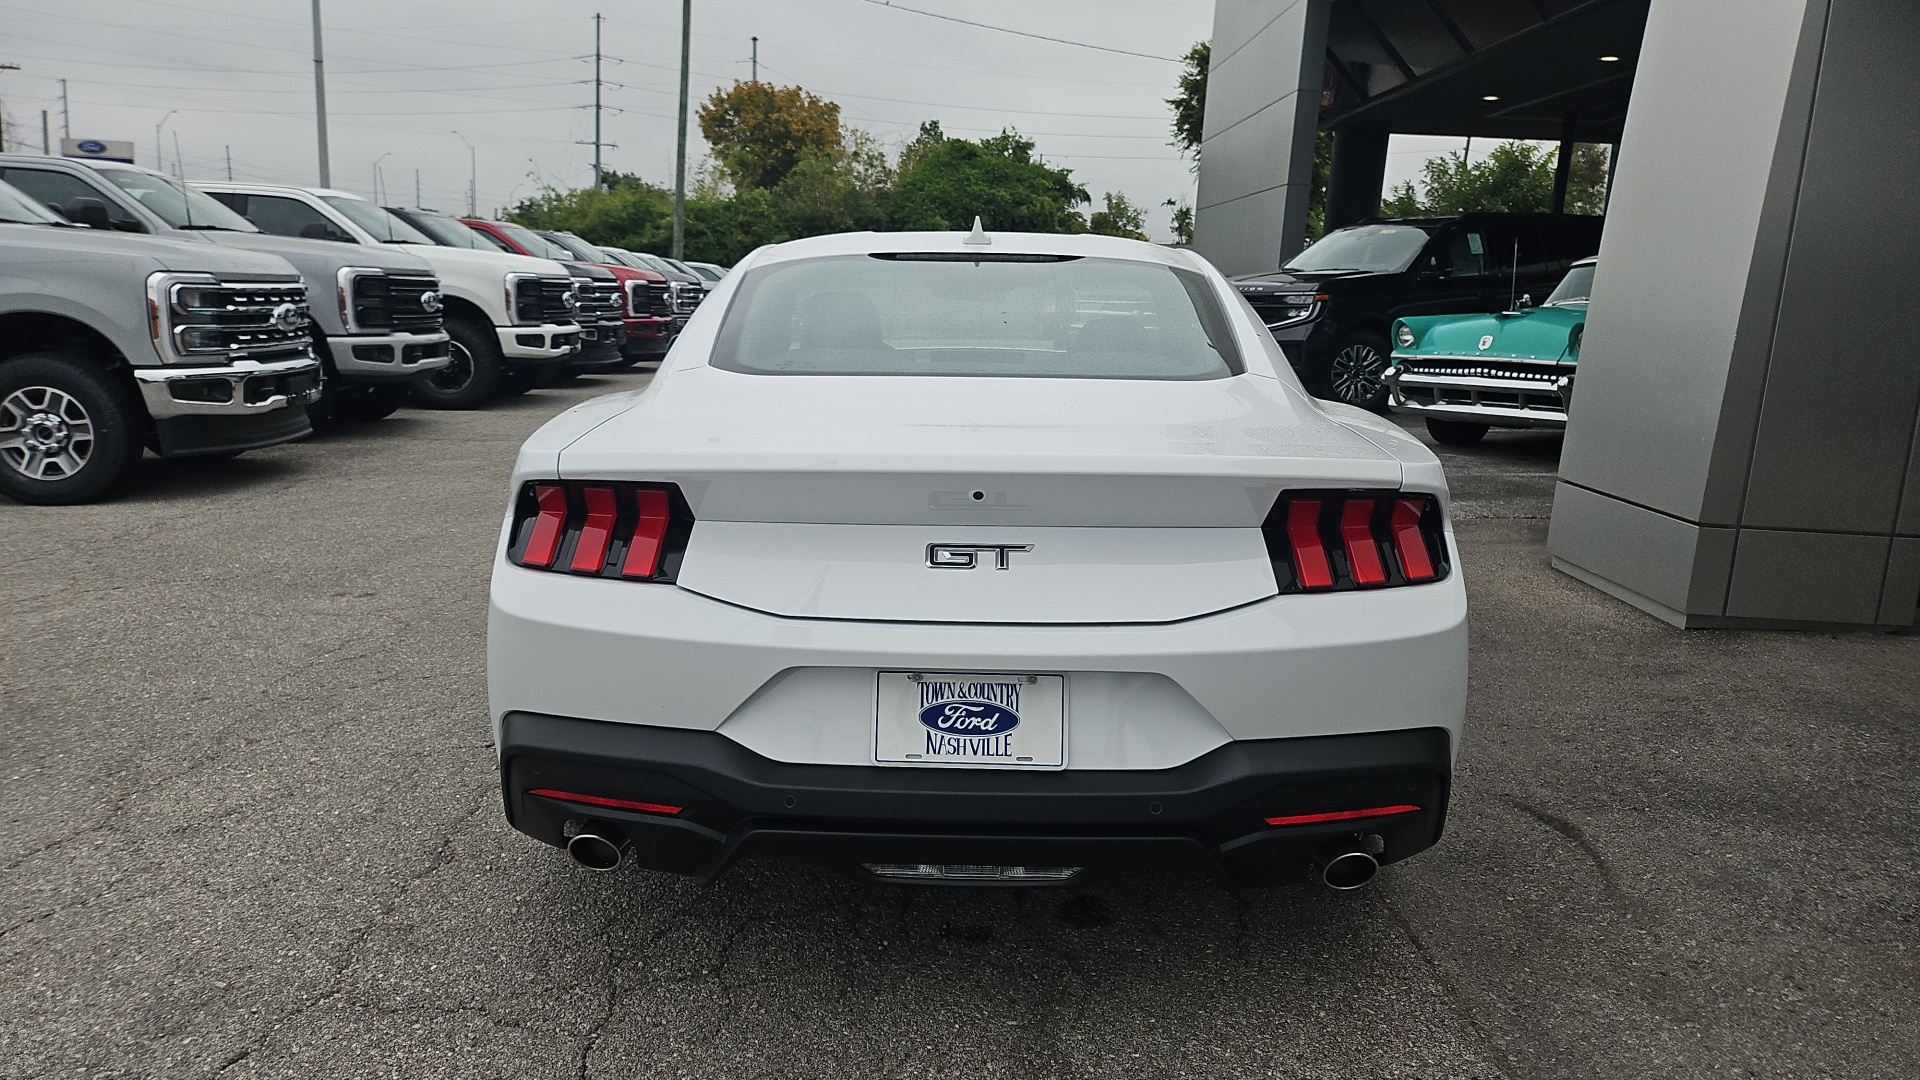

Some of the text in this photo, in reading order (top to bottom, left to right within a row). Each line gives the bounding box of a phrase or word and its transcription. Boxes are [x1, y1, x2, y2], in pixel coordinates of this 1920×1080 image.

[925, 543, 1035, 570] GT
[917, 681, 1022, 712] TOWN & COUNTRY
[937, 703, 1000, 731] Ford
[926, 730, 1012, 757] NASHVILLE
